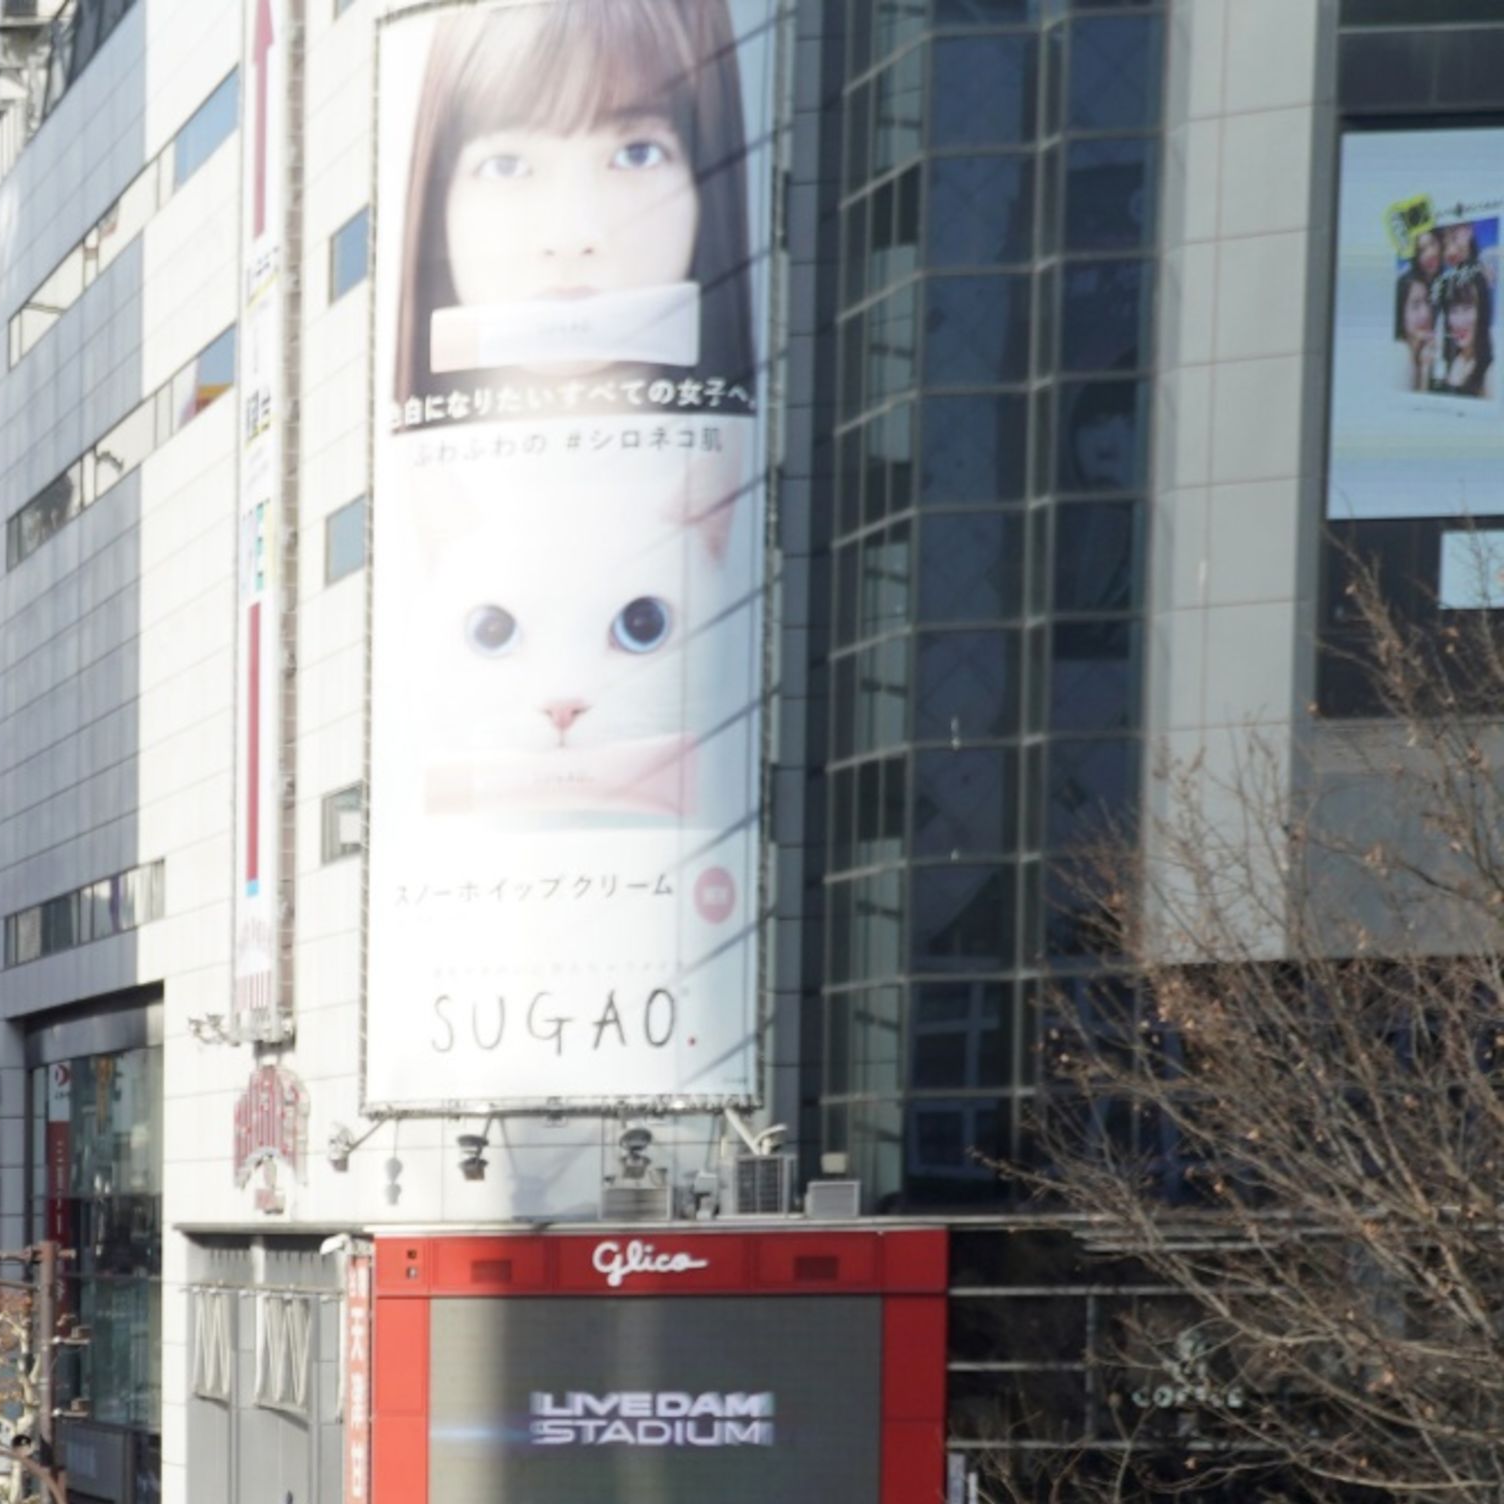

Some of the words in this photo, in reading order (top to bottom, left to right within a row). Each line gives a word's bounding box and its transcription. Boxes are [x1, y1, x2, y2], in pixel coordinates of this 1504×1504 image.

[592, 1241, 708, 1286] Glico
[532, 1392, 652, 1417] LIVE
[655, 1392, 772, 1417] DAM
[532, 1418, 772, 1446] STADIUM
